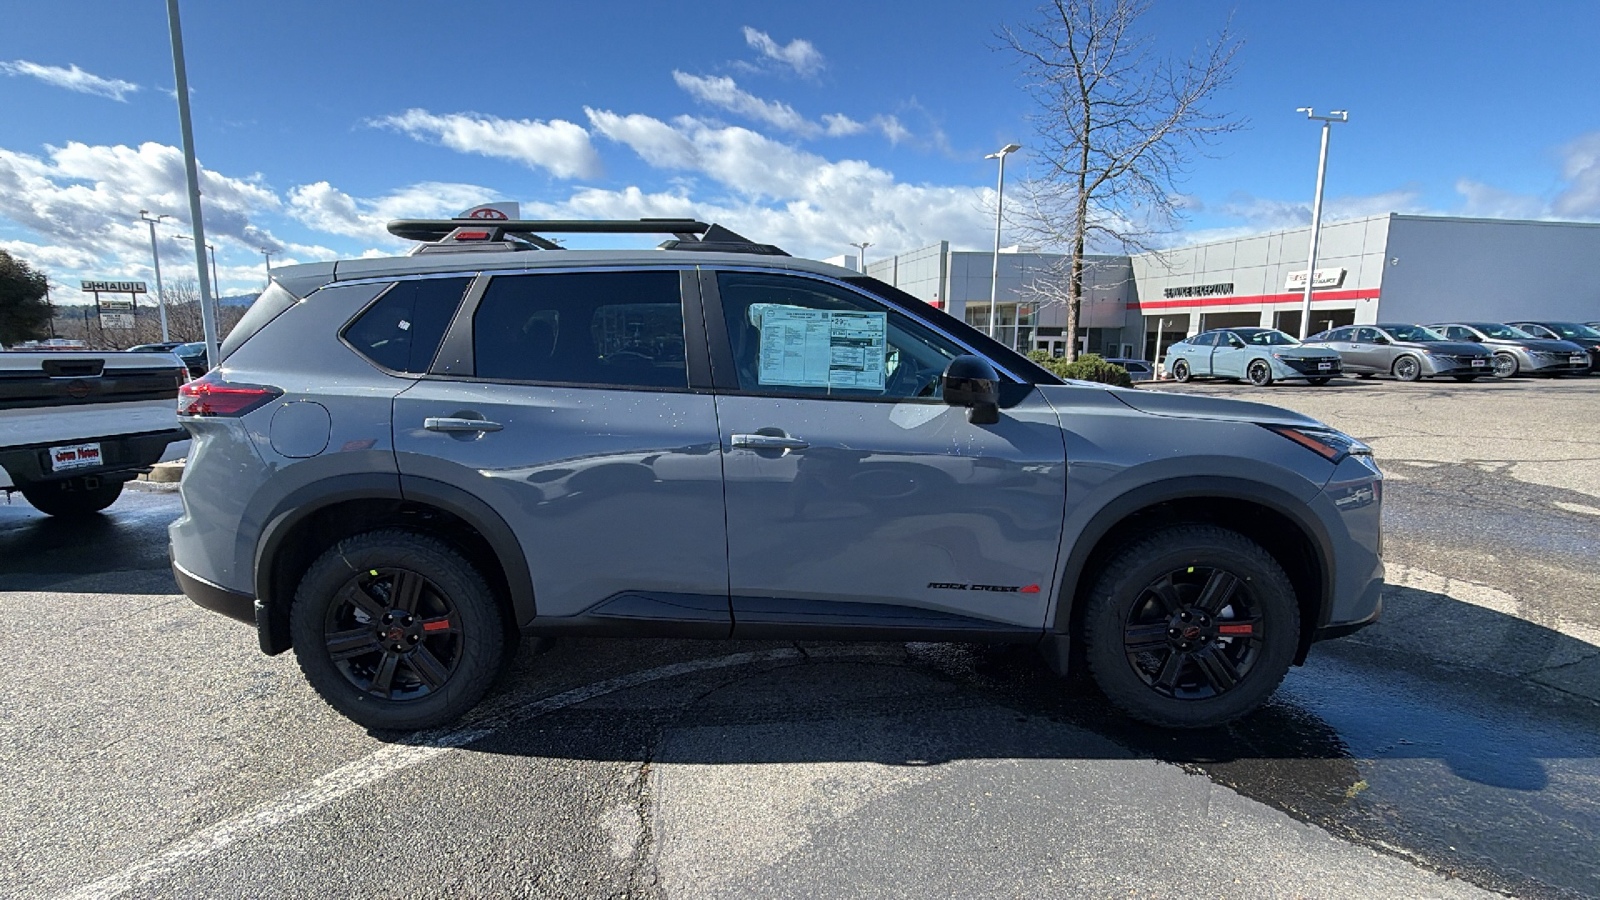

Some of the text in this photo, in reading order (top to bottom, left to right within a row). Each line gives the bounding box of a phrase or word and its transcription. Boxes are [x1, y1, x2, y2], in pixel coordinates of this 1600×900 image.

[1164, 283, 1234, 298] SERVICE RECEPTION
[927, 582, 1020, 592] ROCK CREEK
